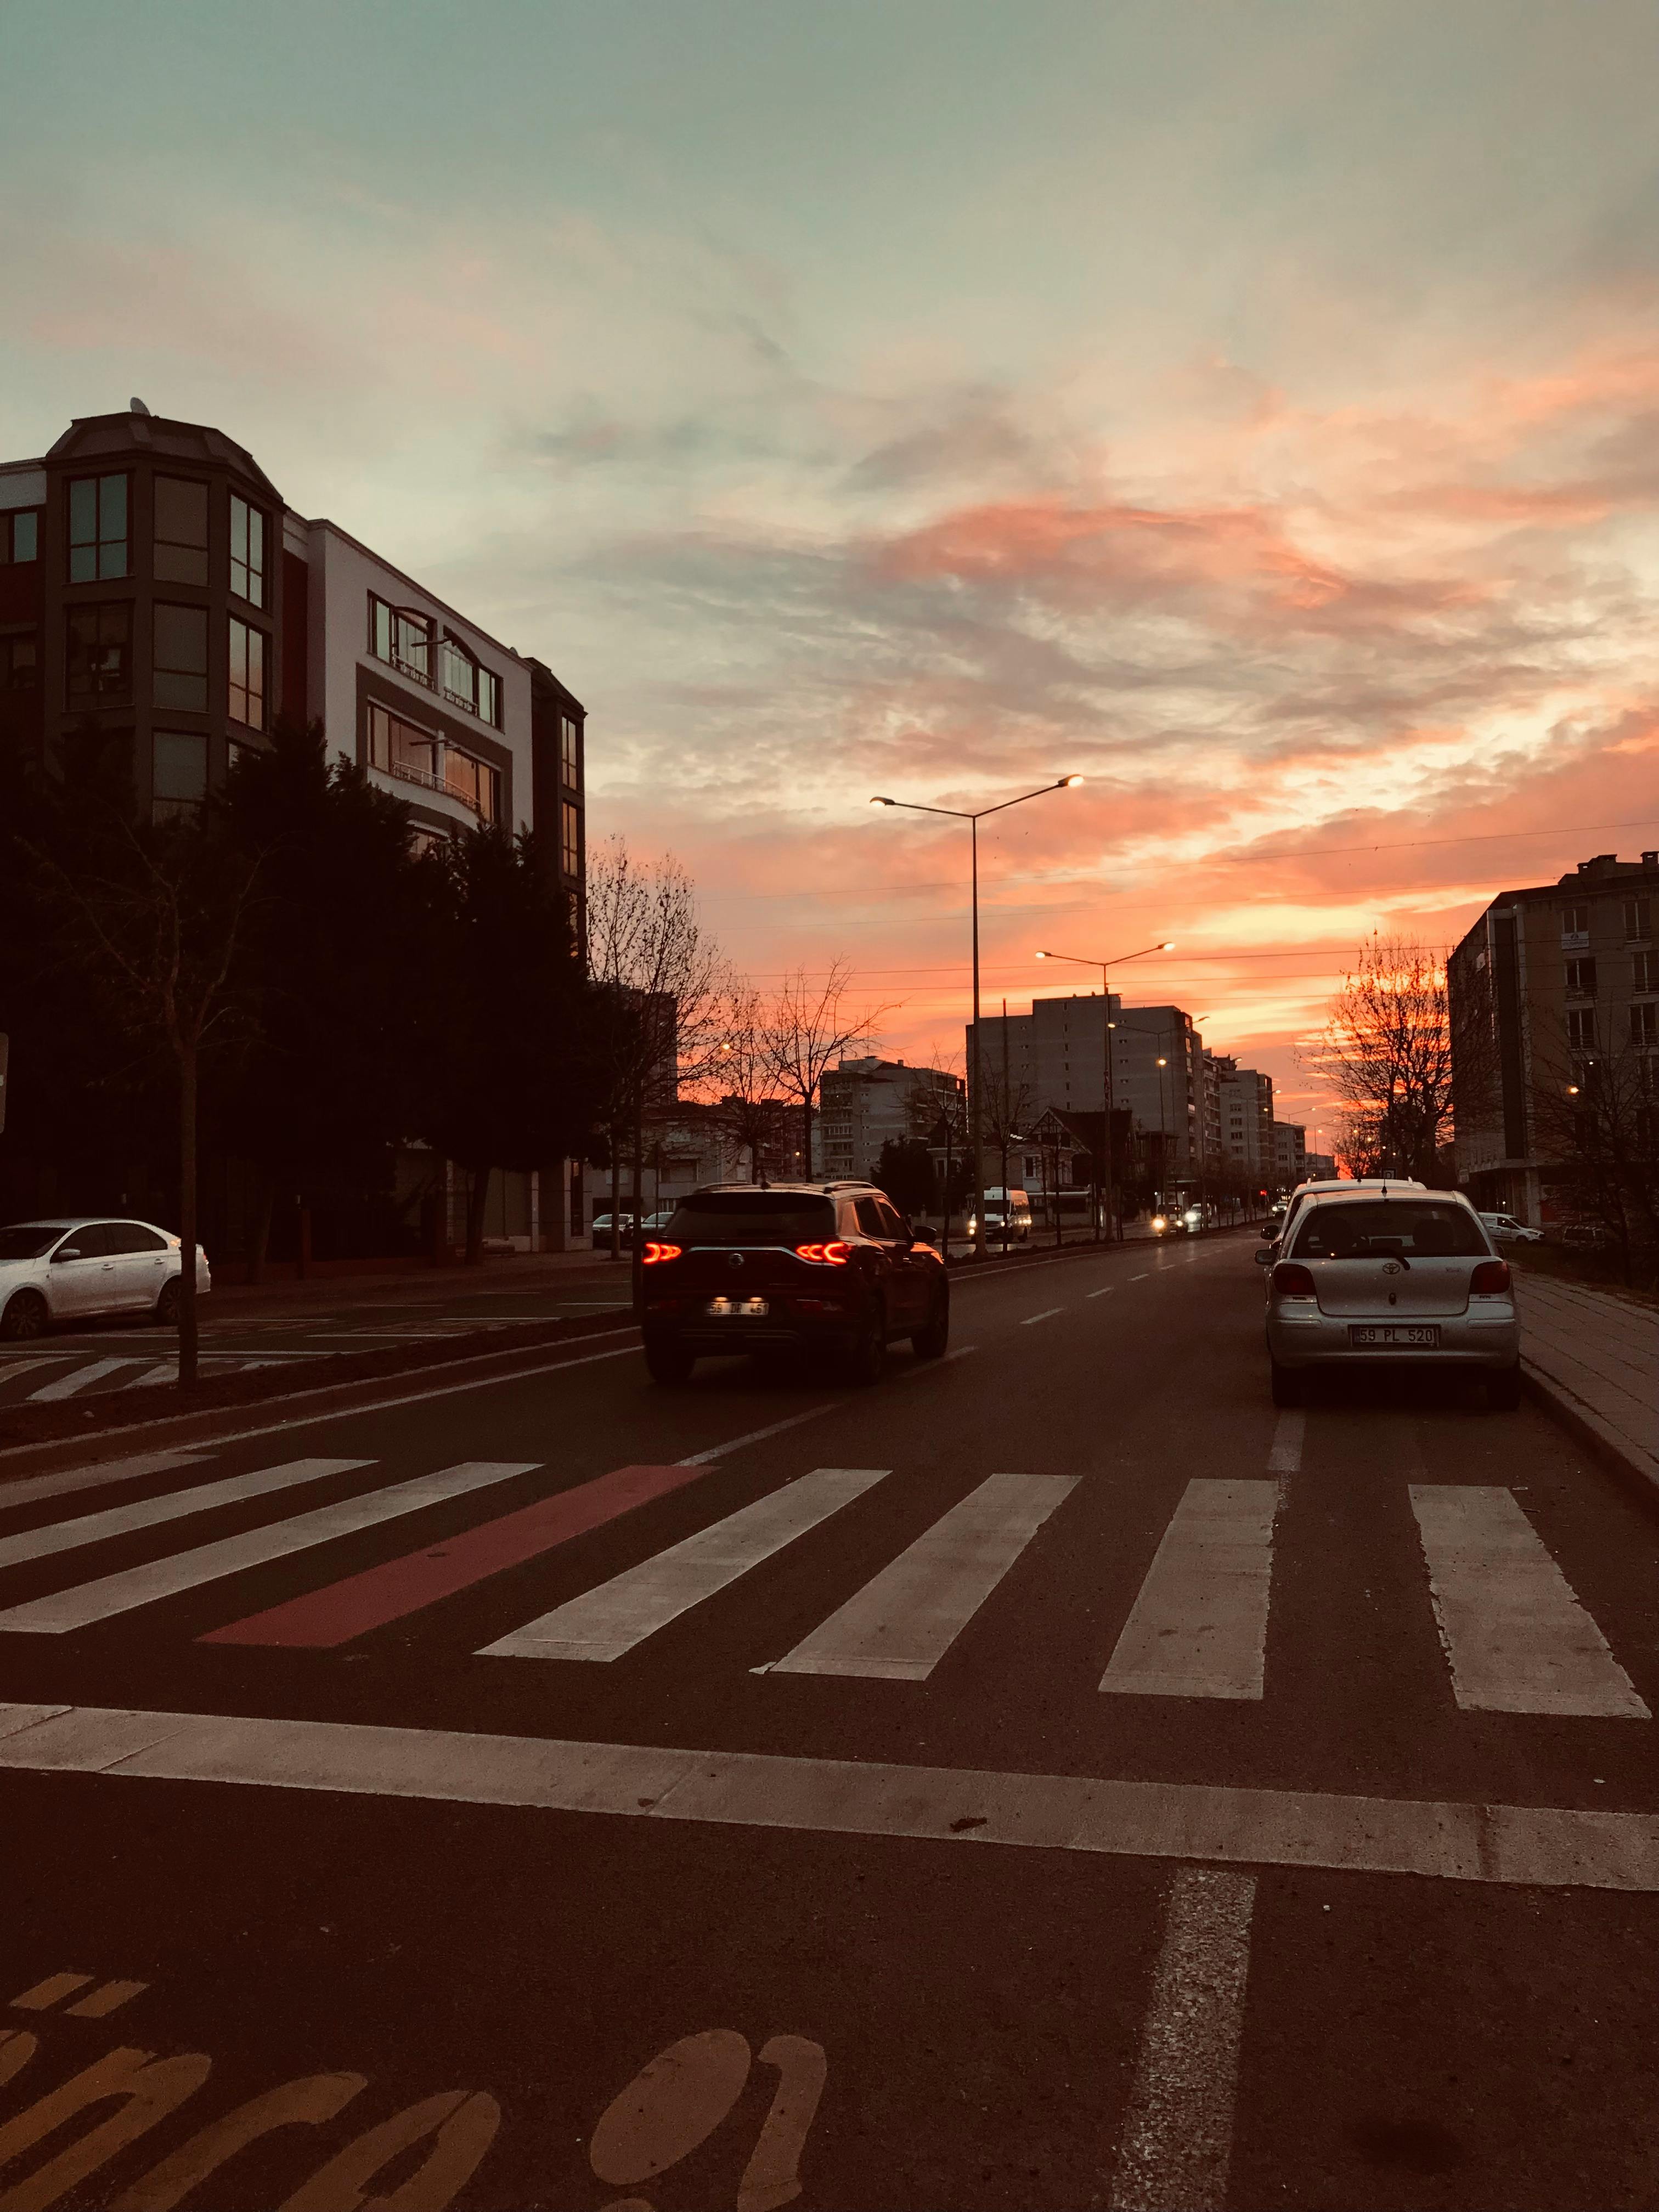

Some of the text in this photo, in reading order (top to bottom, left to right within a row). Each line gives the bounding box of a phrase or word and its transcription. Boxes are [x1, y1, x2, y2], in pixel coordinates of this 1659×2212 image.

[1360, 1329, 1432, 1342] 59 PL 520
